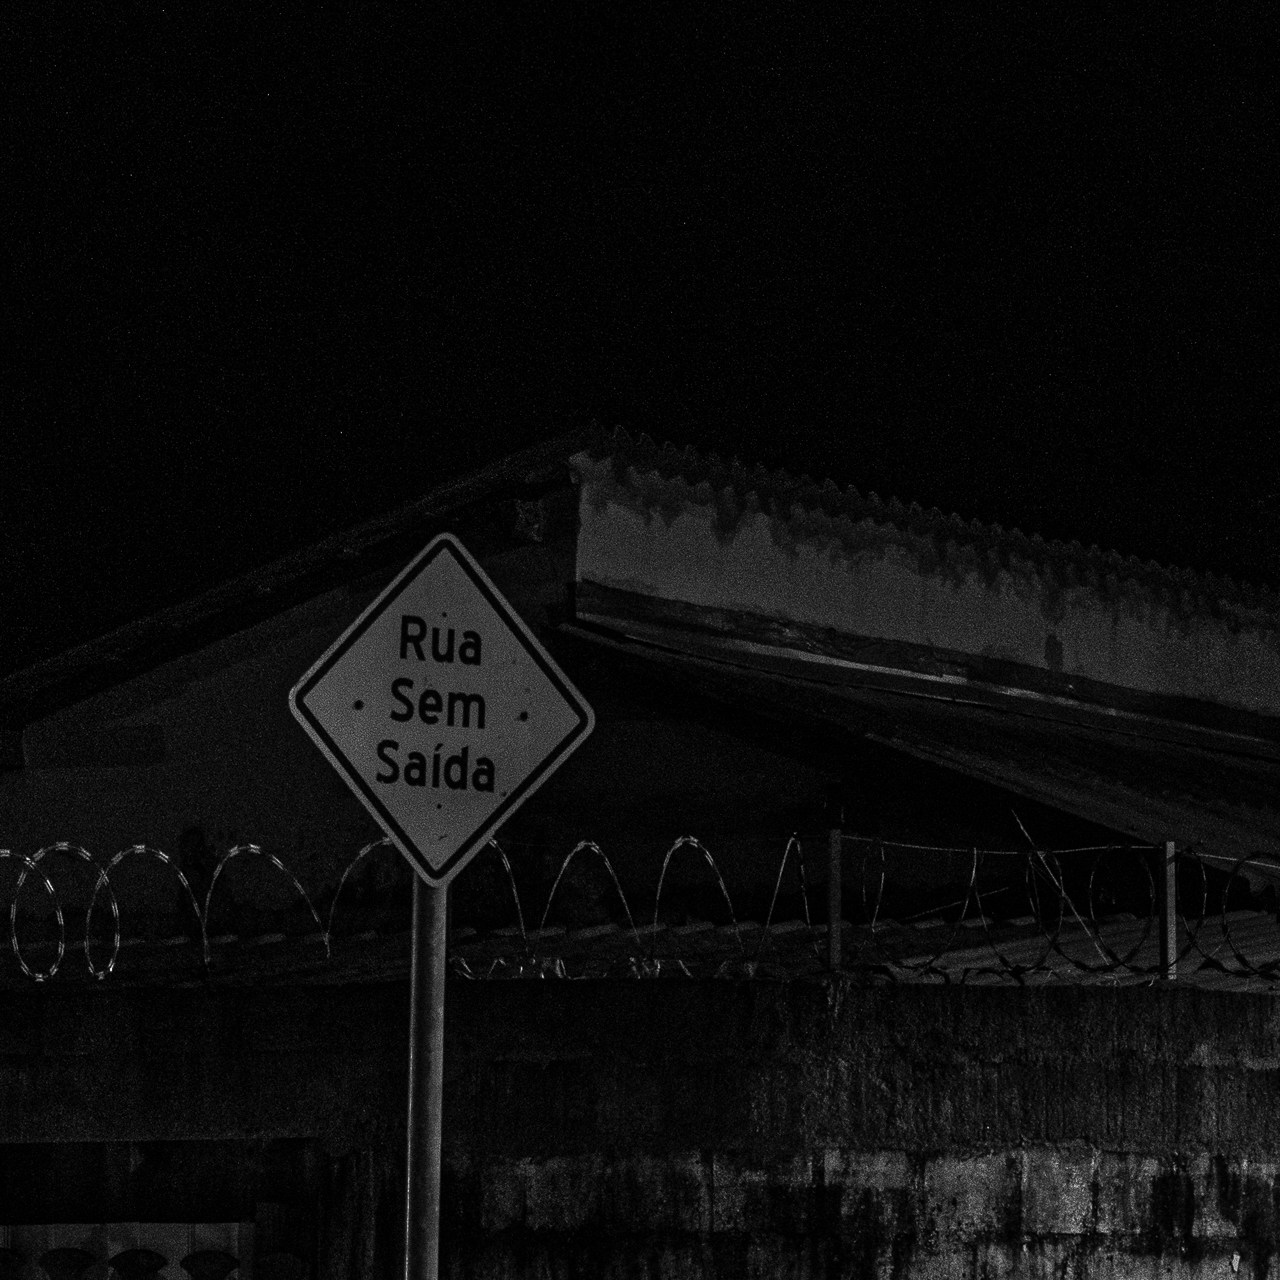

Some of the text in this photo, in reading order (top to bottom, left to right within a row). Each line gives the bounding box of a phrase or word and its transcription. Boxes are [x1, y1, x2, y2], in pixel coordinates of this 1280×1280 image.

[399, 614, 482, 666] Rua
[389, 677, 485, 729] Sem
[375, 739, 495, 793] Saída
